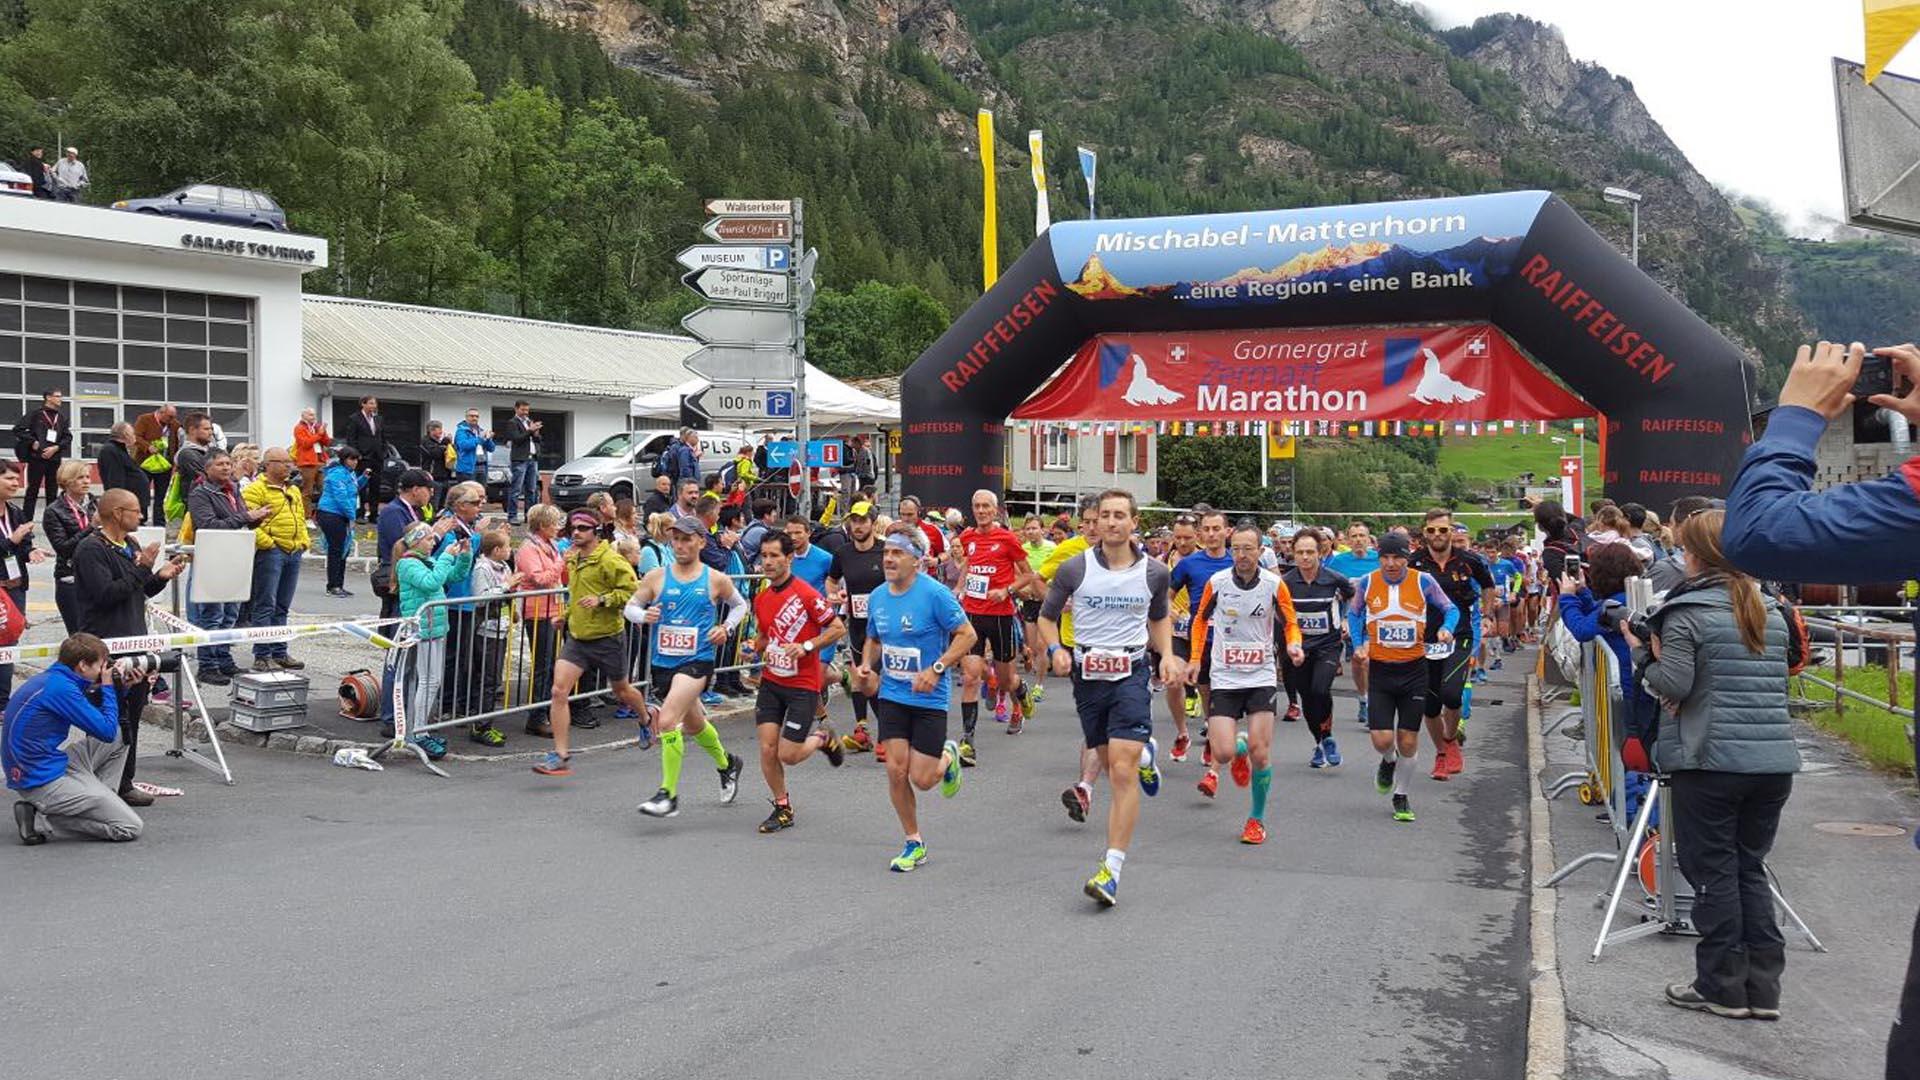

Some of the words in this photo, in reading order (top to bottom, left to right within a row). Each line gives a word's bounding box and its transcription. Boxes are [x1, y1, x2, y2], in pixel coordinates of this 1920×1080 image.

[180, 233, 246, 255] GARAGE
[247, 242, 316, 263] TOURING
[700, 253, 746, 264] MUSEUM
[720, 270, 774, 288] Sportanlage
[1247, 277, 1328, 300] Region
[1349, 273, 1400, 293] eine
[1410, 267, 1474, 290] Bank
[1519, 252, 1677, 384] RAIFFEISEN
[940, 279, 1059, 393] RAIFFEISEN
[1233, 338, 1369, 365] Gornergrat
[719, 396, 744, 410] 100
[748, 398, 761, 410] m
[1196, 384, 1368, 413] Marathon
[1641, 418, 1724, 434] RAIFFEISEN
[1639, 470, 1721, 486] RAIFFEISEN
[1105, 596, 1145, 604] RUNNERS
[1302, 619, 1322, 629] 212
[661, 633, 693, 649] 5185
[1384, 628, 1409, 641] 248
[111, 638, 166, 652] RAIFFEISEN
[1428, 643, 1448, 655] 294
[768, 653, 792, 669] 5163
[888, 654, 911, 671] 357
[1089, 657, 1125, 672] 5514
[1228, 650, 1261, 664] 5472
